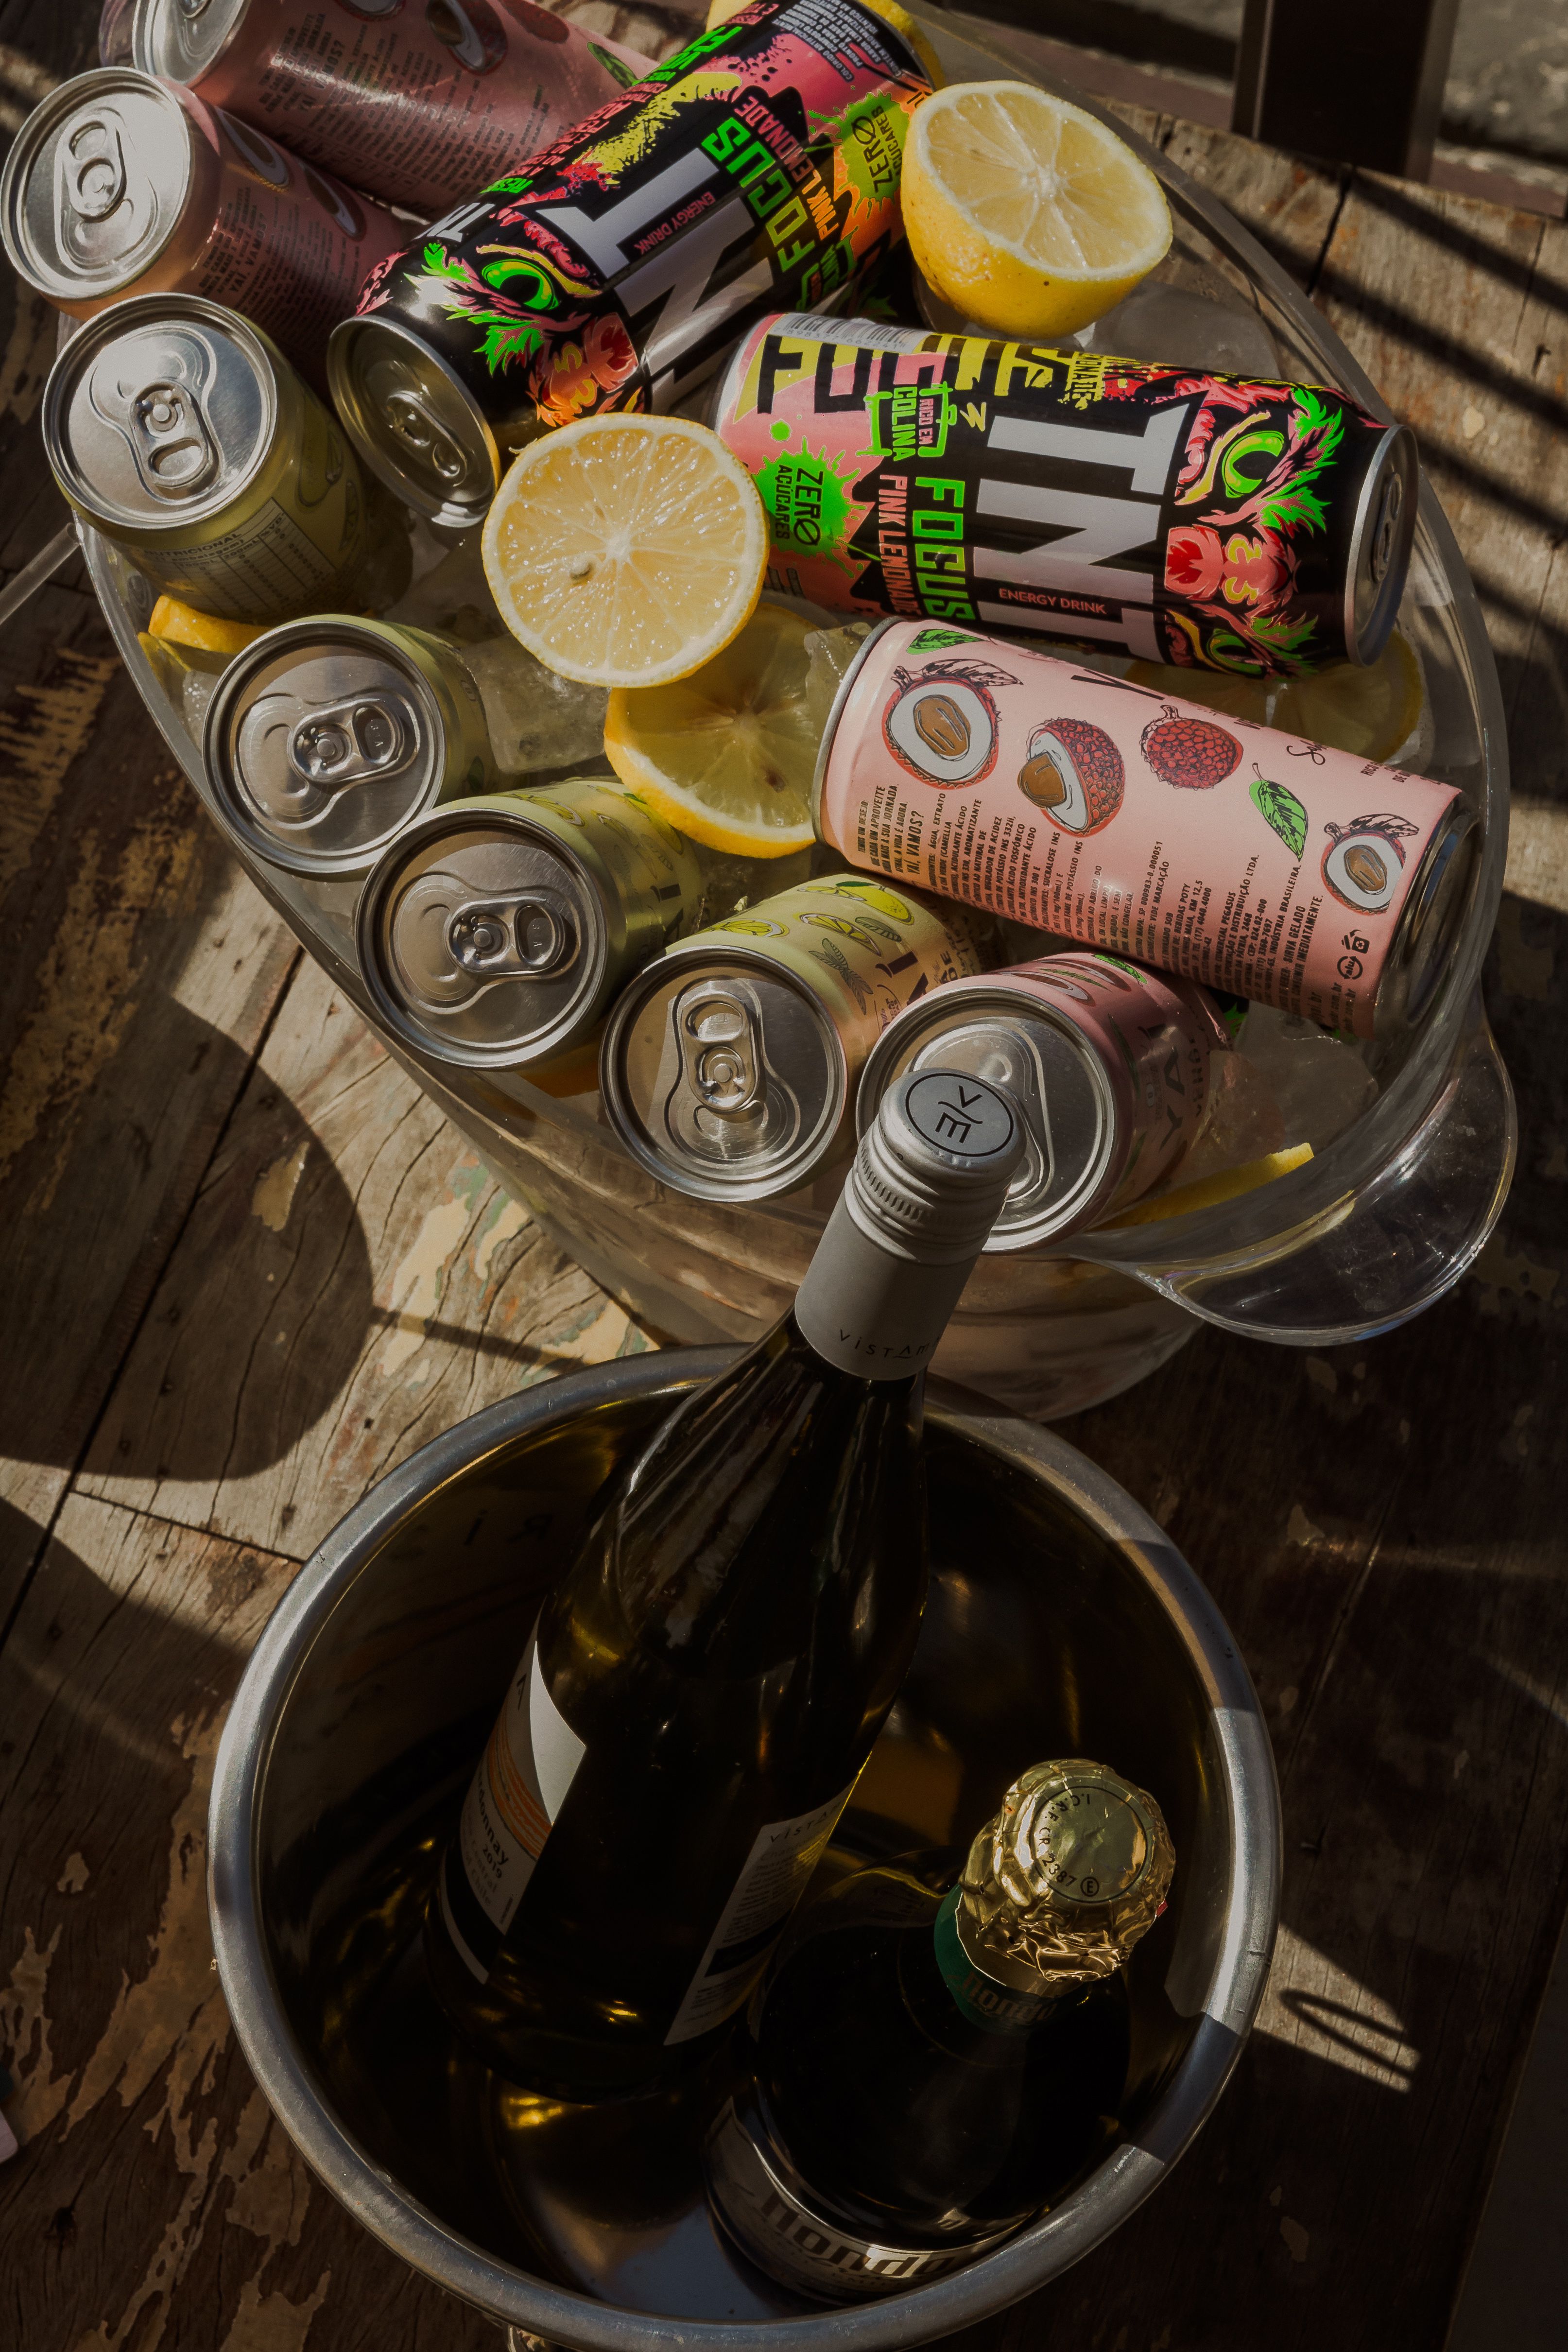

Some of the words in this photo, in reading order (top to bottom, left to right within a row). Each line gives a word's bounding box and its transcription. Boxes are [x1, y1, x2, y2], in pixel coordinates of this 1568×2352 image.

[735, 96, 824, 195] LEMONADE
[672, 192, 716, 224] ENERGY
[701, 117, 816, 273] FOCUS
[807, 186, 840, 241] PINK
[636, 220, 676, 254] DRINK
[892, 387, 916, 461] COLINA
[918, 398, 933, 426] RICO
[918, 429, 933, 445] EM
[775, 465, 791, 538] AÇÚCARES
[879, 474, 908, 533] PINK
[974, 399, 1190, 664] TNT
[913, 476, 974, 621] FOCUS
[882, 534, 918, 617] LEMONADE
[999, 588, 1053, 612] ENERGY
[1059, 595, 1107, 615] DRINK
[859, 799, 868, 825] DESEJO:
[870, 785, 885, 829] APROVEITE
[883, 783, 898, 821] JORNADA.
[932, 793, 946, 825] EXTRATO
[858, 826, 865, 835] UM
[881, 823, 891, 837] SUA
[954, 805, 968, 830] ÁCIDO
[964, 798, 982, 856] AROMATIZANTE
[990, 816, 1002, 844] ACIDEZ
[869, 830, 879, 840] UM
[906, 810, 924, 856] VAMOS?
[928, 828, 940, 848] ÁGUA,
[939, 821, 952, 857] (CAMELLIA
[978, 830, 986, 840] DE
[1000, 839, 1010, 851] INS
[1010, 823, 1025, 864] FOSFÓRICO
[1023, 827, 1036, 851] ÁCIDO
[1073, 840, 1083, 854] INS
[869, 842, 878, 856] CADA
[881, 845, 890, 859] MAIS
[950, 831, 962, 871] ACIDULANTE
[973, 842, 984, 872] NATURAL
[988, 846, 996, 855] DE
[1043, 847, 1056, 887] SUCRALOSE
[1050, 831, 1060, 845] INS
[904, 858, 922, 874] YAÍ,
[962, 858, 970, 871] 330,
[972, 873, 980, 882] AO
[985, 856, 994, 890] REGULADOR
[996, 854, 1007, 884] POTÁSSIO
[1006, 865, 1017, 885] ÁCIDO
[1017, 853, 1031, 899] ANTIOXIDANTE
[1031, 872, 1039, 884] 300
[1067, 857, 1079, 891] POTÁSSIO
[1030, 886, 1038, 896] INS
[1087, 906, 1095, 915] AO
[1094, 865, 1102, 876] DO
[1152, 861, 1169, 903] MARCAÇÃO
[1192, 880, 1203, 896] 12,5
[1230, 879, 1251, 932] DISTRIBUIÇÃO
[1246, 853, 1259, 876] LTDA.
[1066, 893, 1074, 901] DE
[1113, 890, 1121, 904] SEM
[1120, 891, 1133, 926] CONGELAR.
[1174, 905, 1186, 934] BEBIDAS
[1180, 883, 1190, 903] POTY
[1189, 899, 1198, 912] KM
[1196, 887, 1212, 925] 4040.4000
[1268, 914, 1284, 954] INDÚSTRIA
[1280, 864, 1301, 912] BRASILEIRA.
[1138, 907, 1146, 916] SP
[1150, 906, 1159, 921] VIDE
[1164, 912, 1173, 925] SOB
[1185, 914, 1195, 934] MAIA,
[1241, 912, 1252, 931] 2468
[1288, 905, 1305, 938] GELADO
[1136, 918, 1145, 936] MAPA:
[1194, 927, 1203, 941] (17)
[1216, 927, 1227, 962] COMERCIAL
[1222, 891, 1236, 924] PEGASUS
[1258, 918, 1273, 955] 3360-7697
[1296, 894, 1323, 961] IMEDIATAMENTE.
[1236, 934, 1247, 958] PÁTRIA,
[1247, 942, 1256, 956] CEP:
[1283, 940, 1296, 963] SIRVA
[1345, 961, 1355, 975] alu
[481, 1844, 504, 1879] 2019
[1042, 1857, 1077, 1886] 2387
